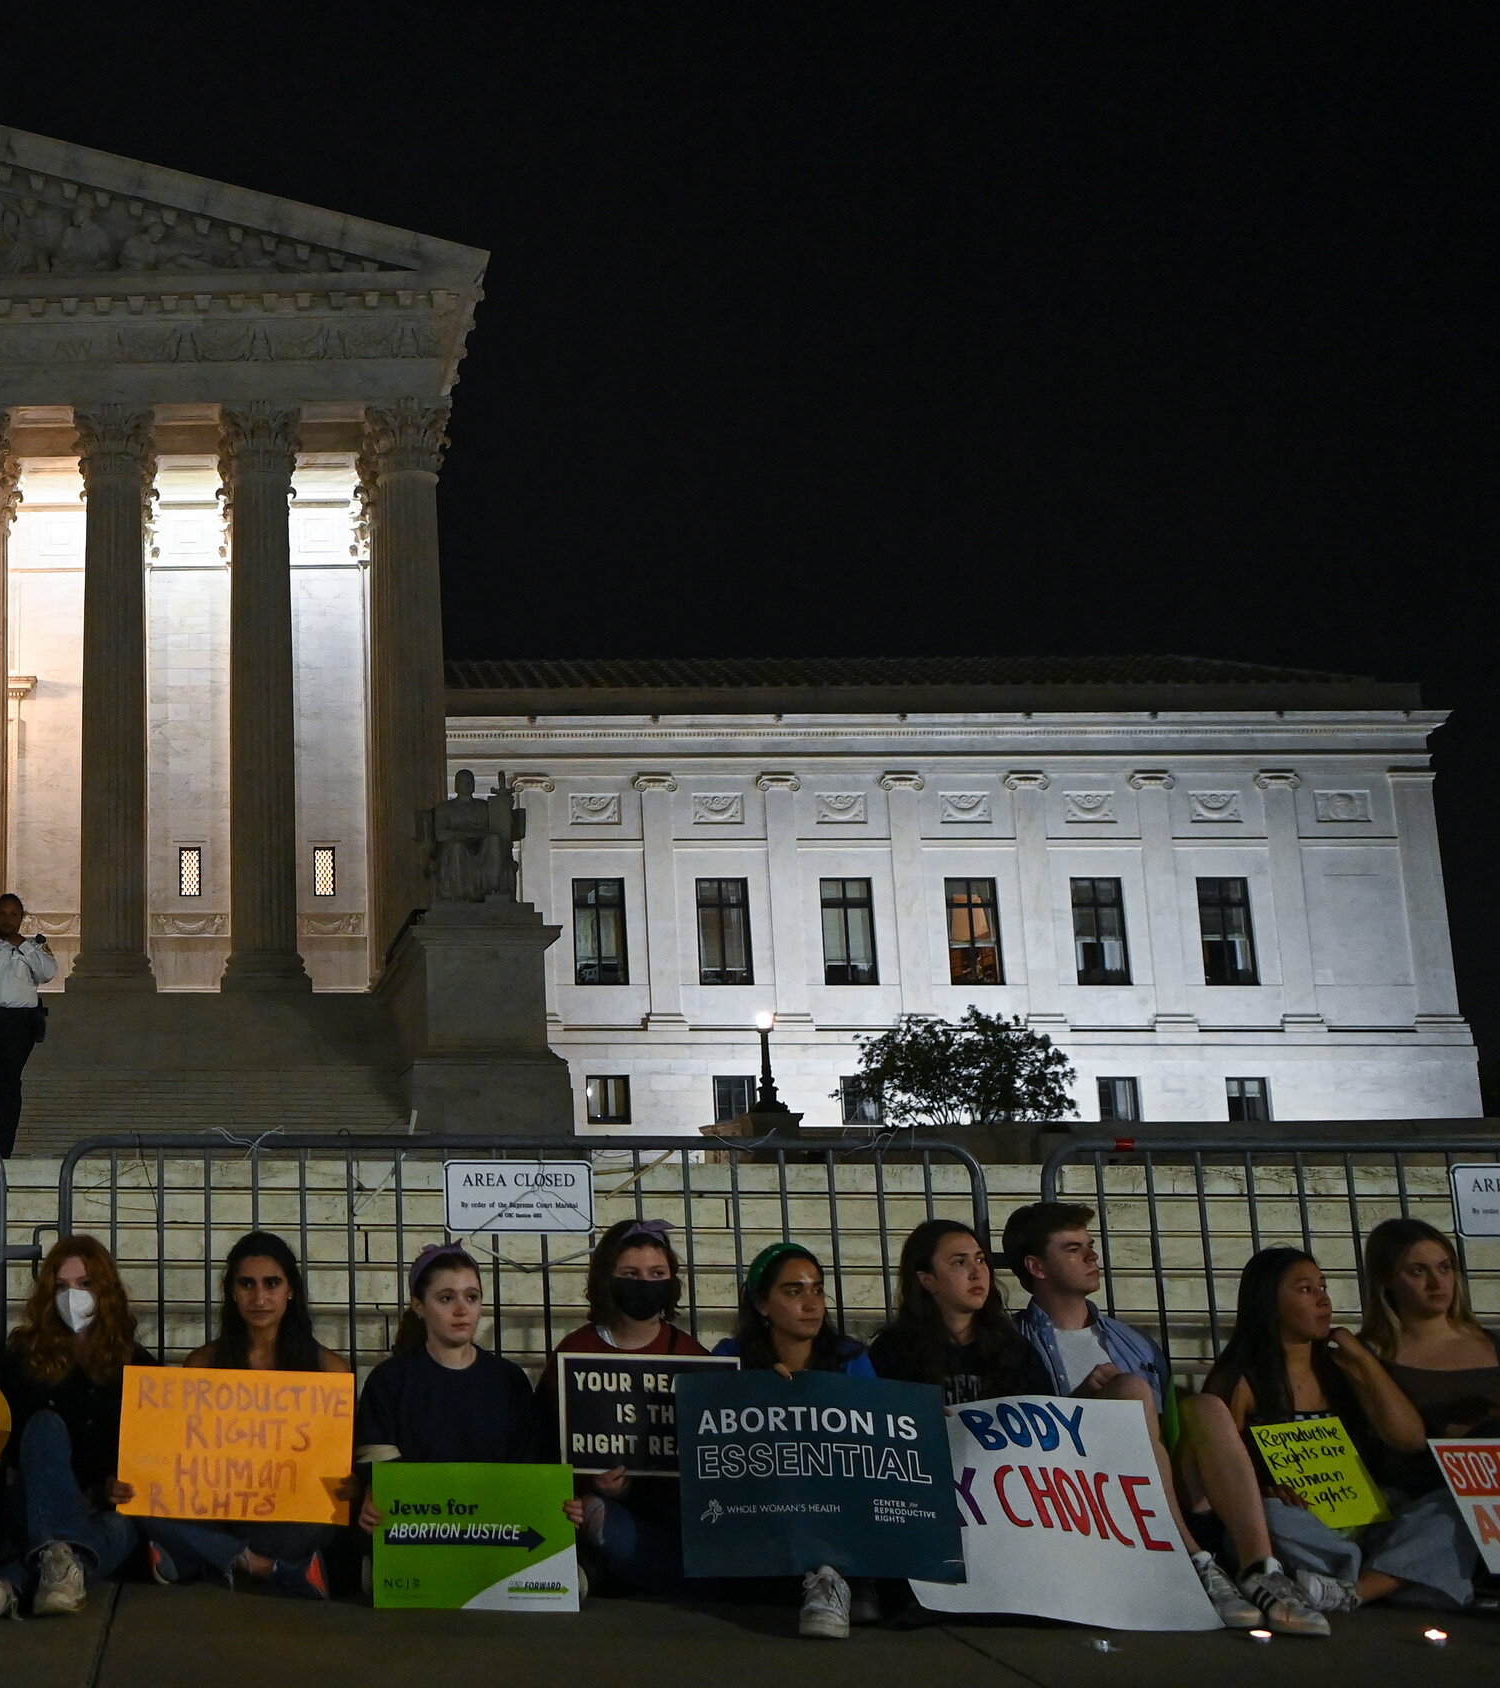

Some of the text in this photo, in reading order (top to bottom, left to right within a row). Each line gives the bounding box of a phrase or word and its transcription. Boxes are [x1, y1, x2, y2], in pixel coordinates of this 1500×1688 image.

[462, 1172, 575, 1187] AREA CLOSED
[460, 1201, 468, 1209] By
[573, 1371, 632, 1392] YOUR
[137, 1374, 350, 1418] REPRODUCTIVE
[616, 1403, 637, 1424] IS
[697, 1406, 918, 1440] ABORTION IS
[185, 1412, 311, 1453] RIGHTS
[958, 1402, 1086, 1457] BODY
[1256, 1427, 1341, 1449] Reproductive
[572, 1432, 679, 1456] RIGHT RE
[696, 1442, 933, 1485] ESSENTIAL
[1267, 1445, 1345, 1473] Rights are
[1278, 1470, 1345, 1488] Human
[1442, 1451, 1499, 1489] STOP
[149, 1481, 277, 1519] RIGHTS
[389, 1498, 479, 1516] Jews for
[726, 1503, 841, 1513] WHOLE WOMAN'S HEALTH
[873, 1498, 906, 1508] CENTER
[954, 1465, 1174, 1551] Y CHOICE
[874, 1506, 937, 1518] REPRODUCTIVE
[874, 1514, 906, 1524] RIGHTS
[388, 1522, 521, 1541] ABORTION JUSTICE
